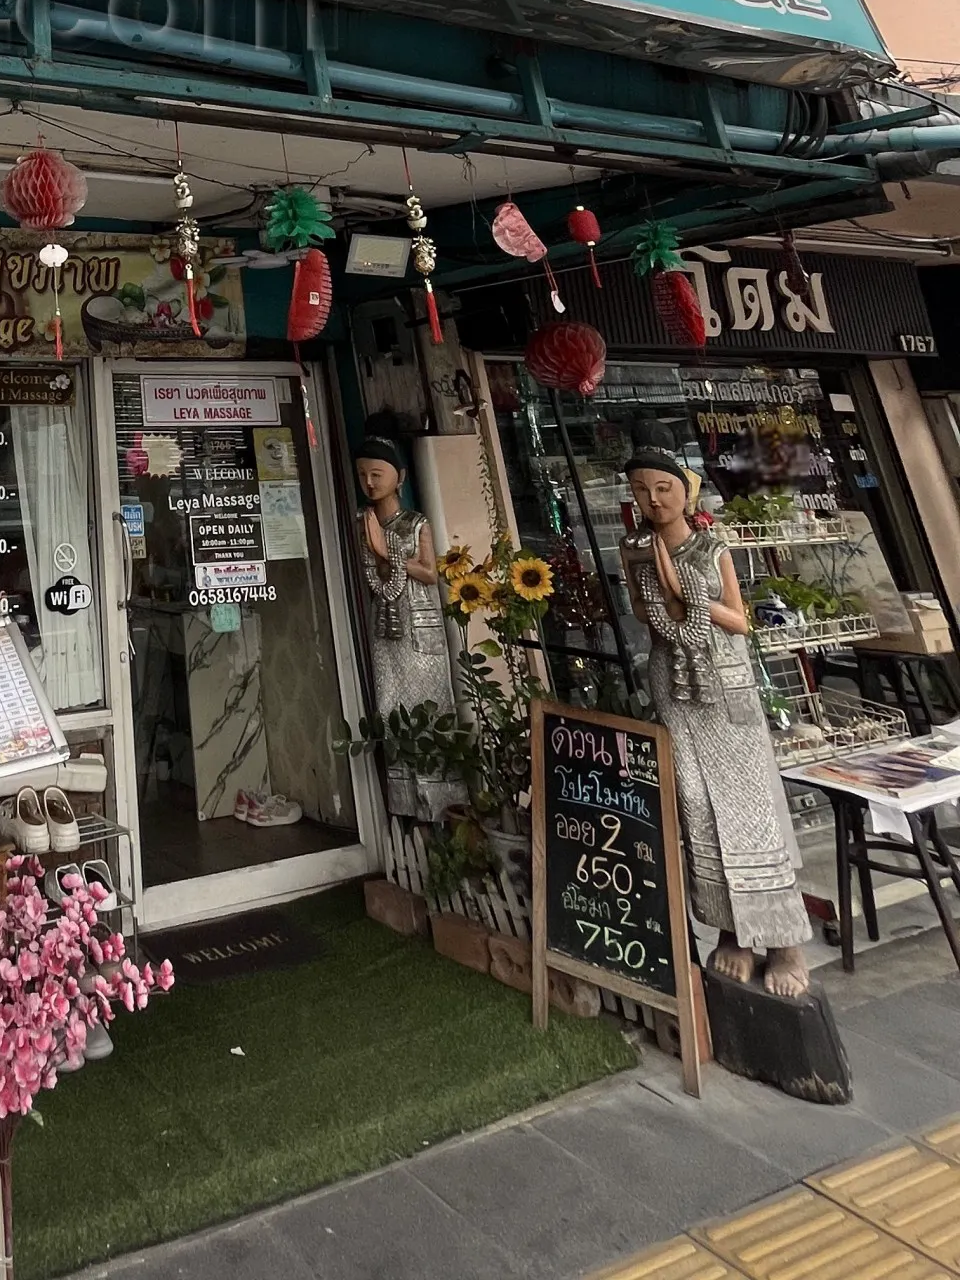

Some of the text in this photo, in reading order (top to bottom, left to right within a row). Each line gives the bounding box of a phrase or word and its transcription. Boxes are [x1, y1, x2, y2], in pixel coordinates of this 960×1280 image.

[900, 335, 935, 352] 1767
[9, 387, 63, 404] Massage
[154, 382, 267, 404] เรยา นวดเพื่อสุขภาพ
[174, 407, 253, 419] LEYA MASSAGE
[193, 468, 254, 481] WELCOME
[169, 492, 260, 514] Leya Massage
[126, 521, 142, 532] USH
[199, 524, 254, 536] OPEN DAILY
[188, 585, 277, 606] 0658167448
[554, 764, 650, 818] โปรโมชั่น
[555, 813, 596, 847] ออย
[600, 813, 627, 857] 2
[576, 853, 657, 900] 650.-
[616, 898, 639, 928] 2
[575, 919, 669, 972] 750.-
